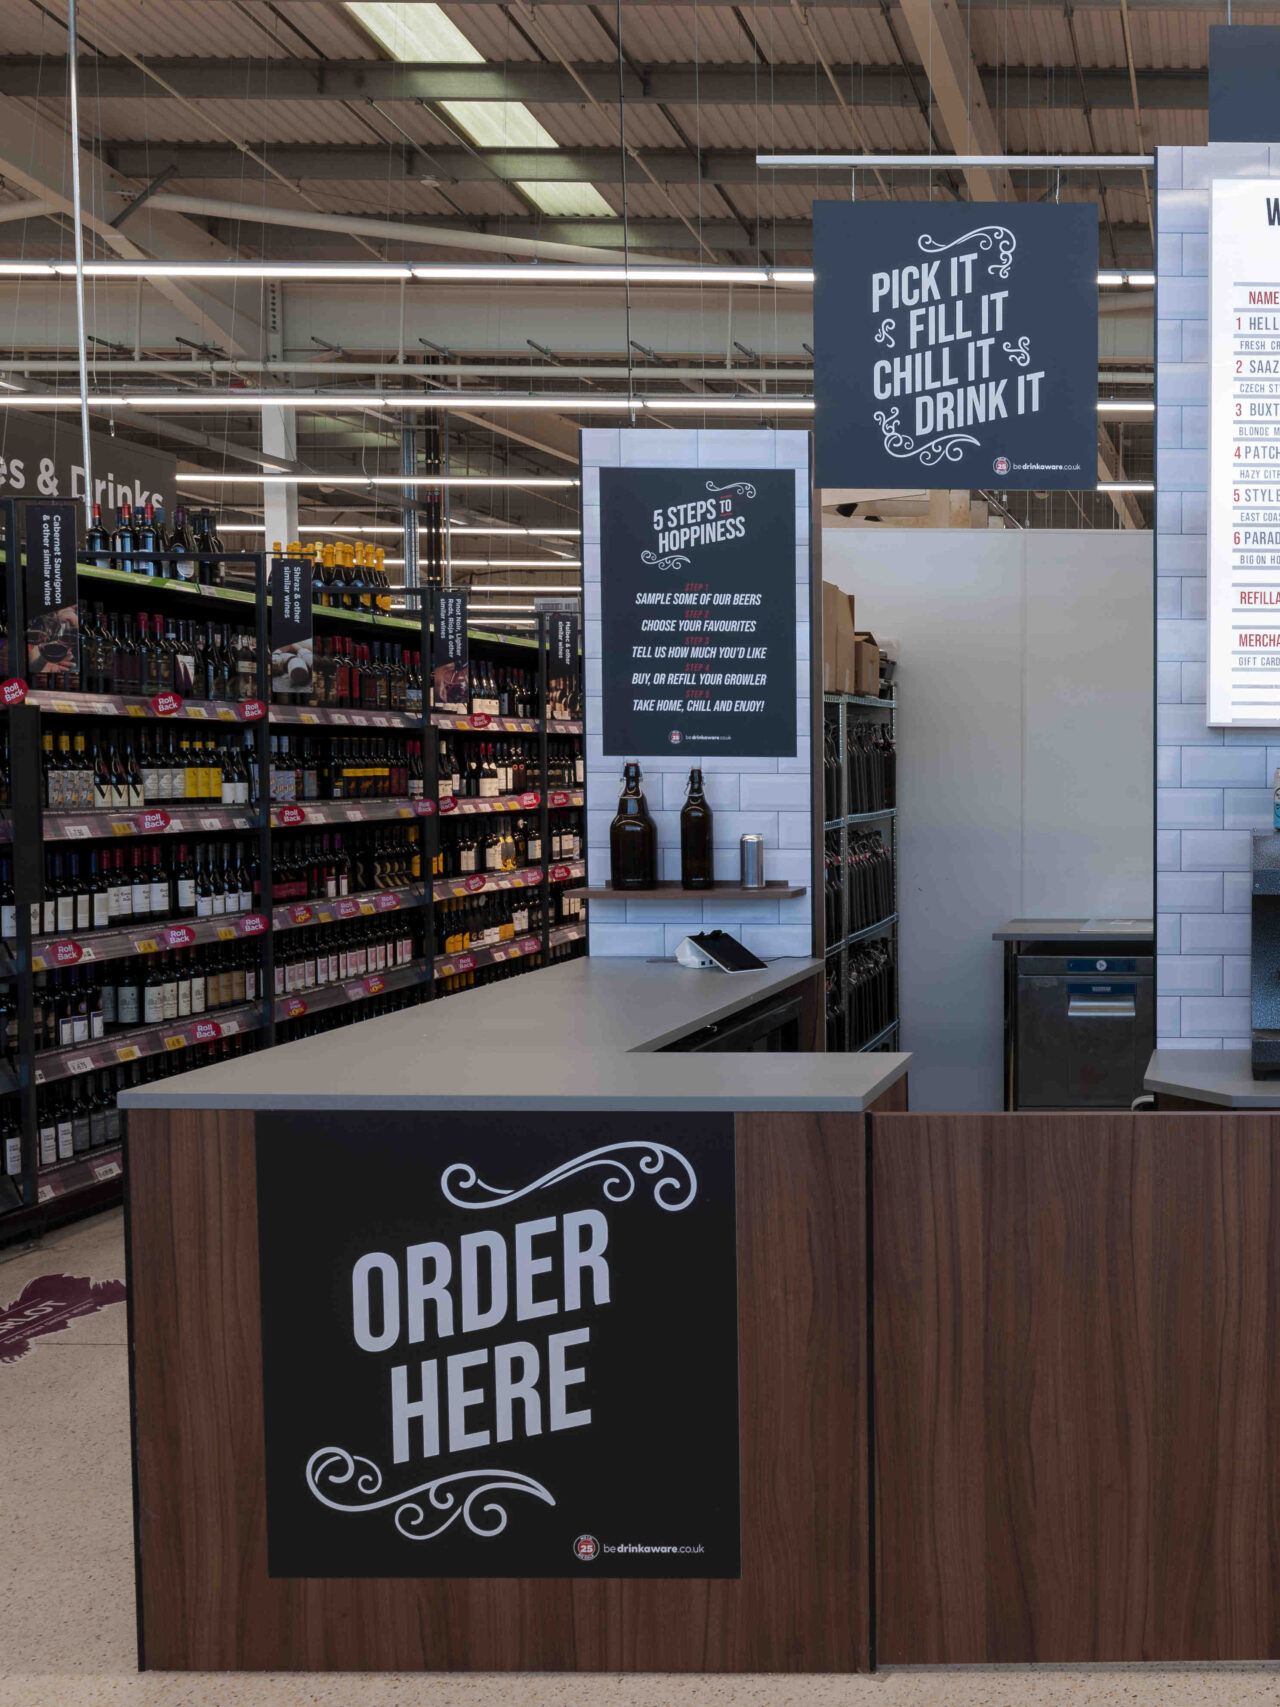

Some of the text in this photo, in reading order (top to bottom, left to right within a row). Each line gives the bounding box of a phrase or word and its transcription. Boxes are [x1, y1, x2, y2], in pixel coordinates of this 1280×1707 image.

[872, 252, 978, 313] PICK IT
[1248, 291, 1280, 305] NAME
[910, 290, 1008, 350] FILL IT
[1240, 340, 1266, 351] FRESH
[873, 337, 996, 400] CHILL IT
[1249, 360, 1280, 374] SAAZ
[915, 371, 1045, 436] DRINK IT
[37, 458, 58, 496] &
[653, 498, 732, 530] 5 STEPS TO
[1240, 512, 1260, 523] EAST
[658, 516, 746, 554] HOPPINESS
[44, 550, 52, 578] similar
[44, 580, 52, 606] wines
[54, 558, 62, 604] Sauvignon
[284, 566, 292, 618] similar wines
[635, 592, 762, 605] SAMPLE SOME OF OUR BEERS
[641, 620, 756, 632] CHOOSE YOUR FAVOURITES
[632, 646, 653, 658] TELL
[654, 647, 666, 658] US
[668, 647, 690, 658] HOW
[690, 647, 717, 659] MUCH
[746, 647, 767, 659] LIKE
[632, 674, 766, 686] BUY, OR REFILL YOUR GROWLER
[633, 700, 764, 712] TAKE HOME, CHILL AND ENJOY!
[352, 1208, 610, 1352] ORDER
[391, 1327, 592, 1464] HERE
